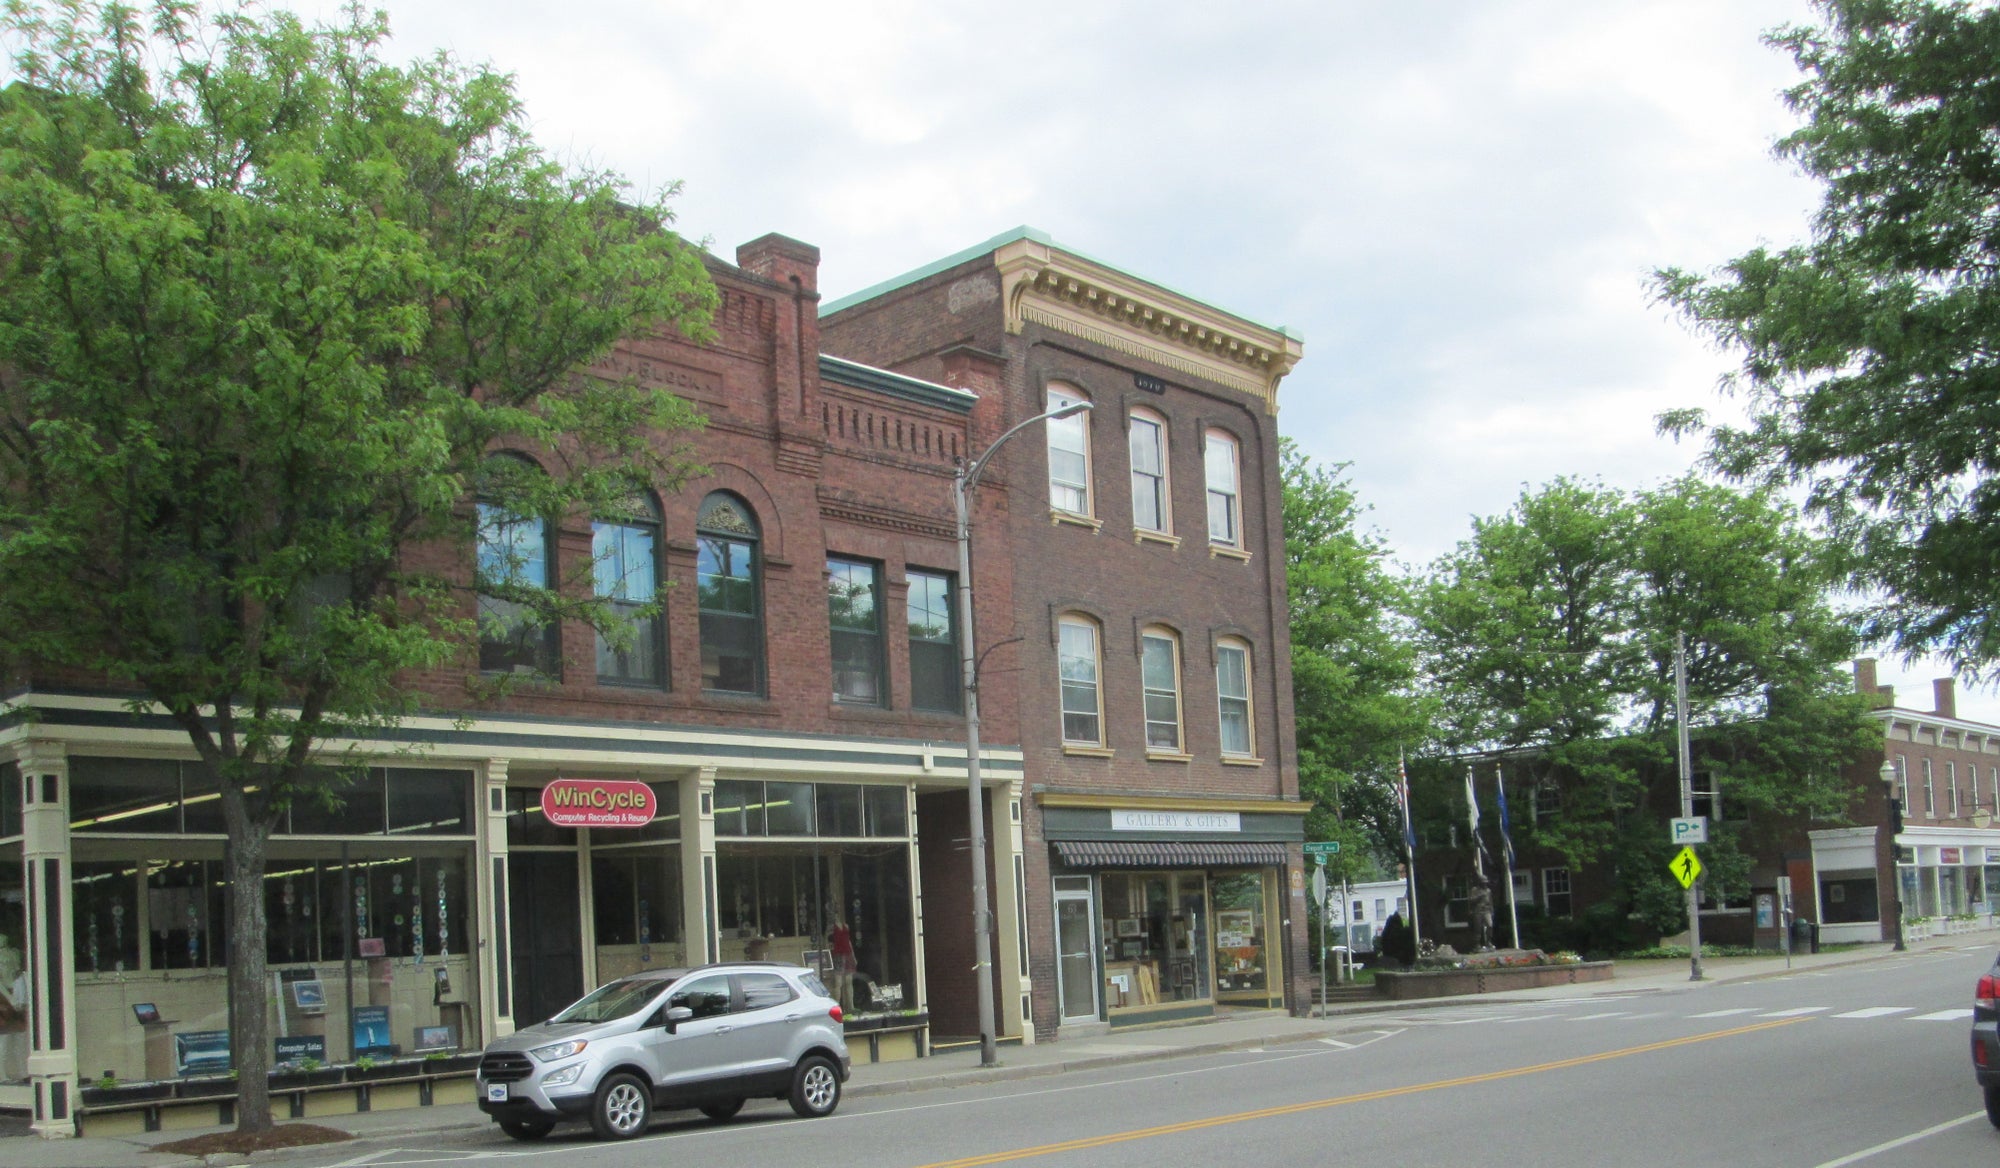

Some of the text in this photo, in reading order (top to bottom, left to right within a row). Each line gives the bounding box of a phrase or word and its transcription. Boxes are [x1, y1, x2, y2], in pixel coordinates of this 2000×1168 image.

[551, 787, 646, 811] WinCycle
[552, 812, 648, 823] Computer Recycling & Reuse
[1126, 813, 1229, 828] GALLERY & GIFTS
